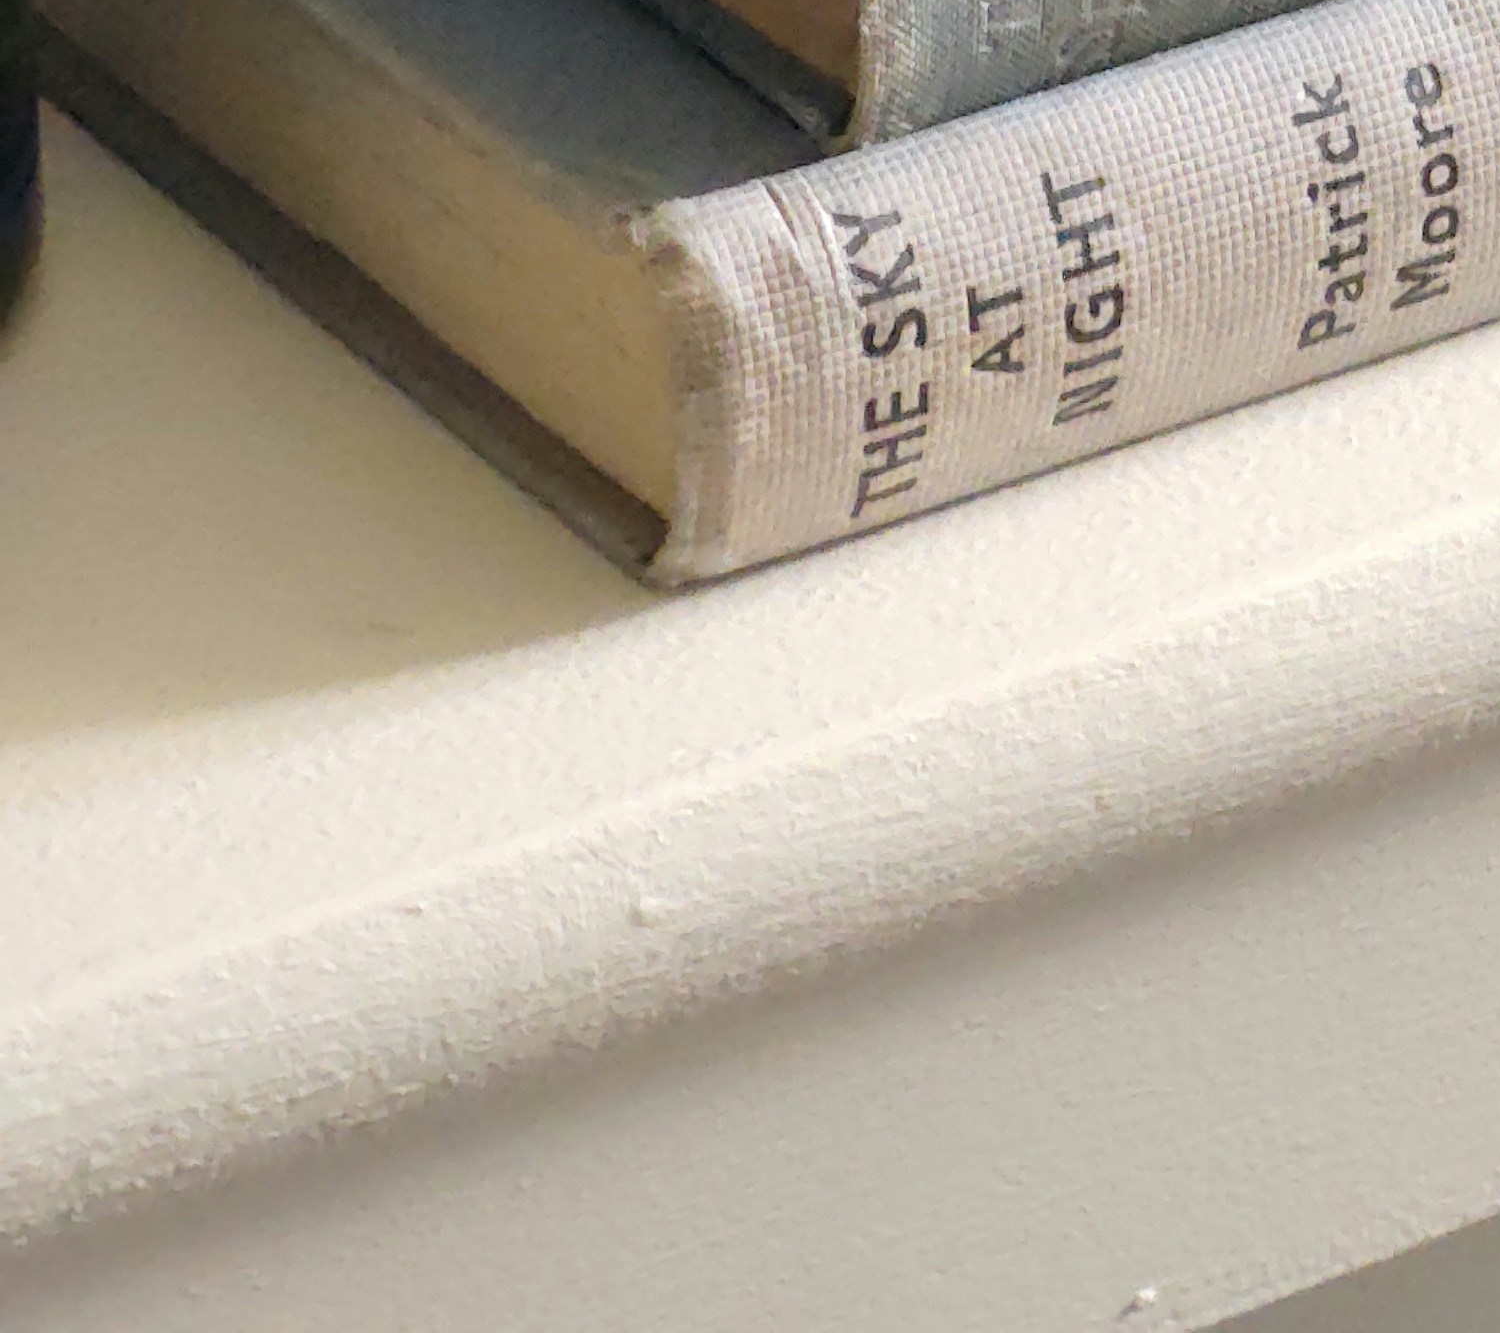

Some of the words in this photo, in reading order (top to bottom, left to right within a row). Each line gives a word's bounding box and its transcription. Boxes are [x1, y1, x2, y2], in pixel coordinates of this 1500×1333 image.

[829, 208, 930, 361] SKY
[1291, 72, 1369, 352] Patrick
[1389, 60, 1462, 312] Moore
[966, 285, 1027, 375] AT
[1039, 171, 1127, 427] NIGHT
[850, 379, 930, 521] THE
